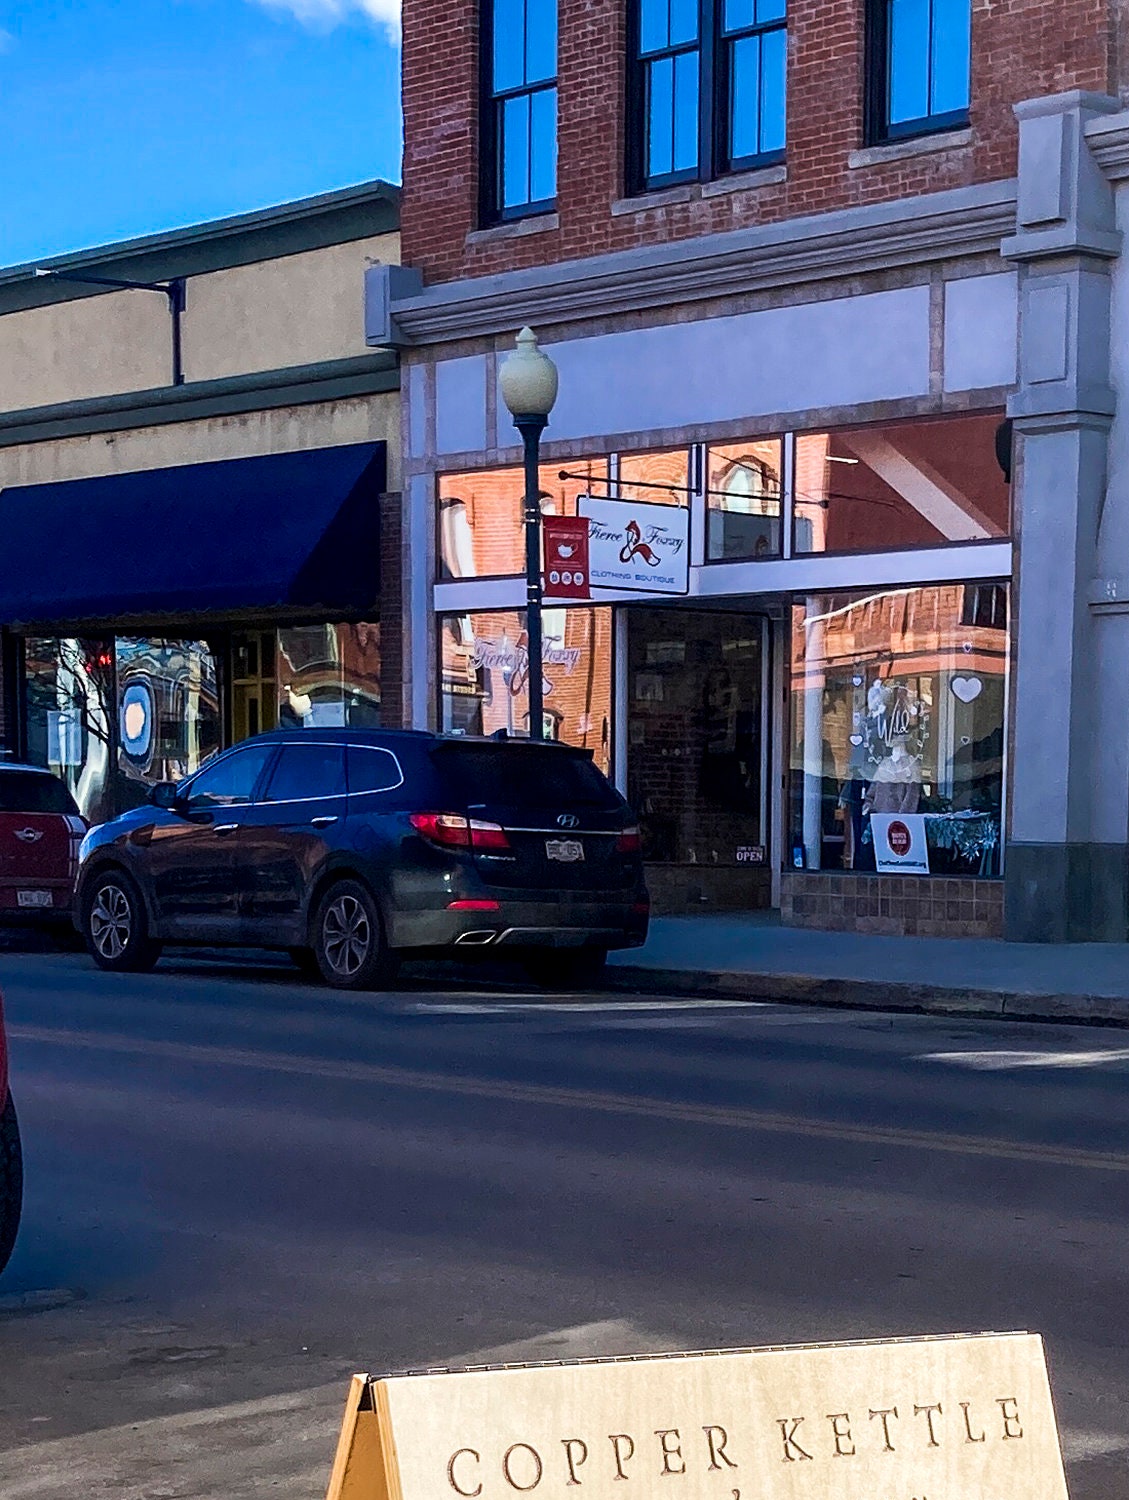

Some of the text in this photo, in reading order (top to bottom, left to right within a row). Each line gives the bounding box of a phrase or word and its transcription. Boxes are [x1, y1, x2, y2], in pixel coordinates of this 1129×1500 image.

[588, 520, 685, 554] Fierce Foxxy
[590, 570, 676, 584] CLOTHING BOUTIQUE
[877, 699, 909, 747] Wild
[736, 851, 763, 861] OPEN
[446, 1396, 1025, 1498] COPPER KETTLE
